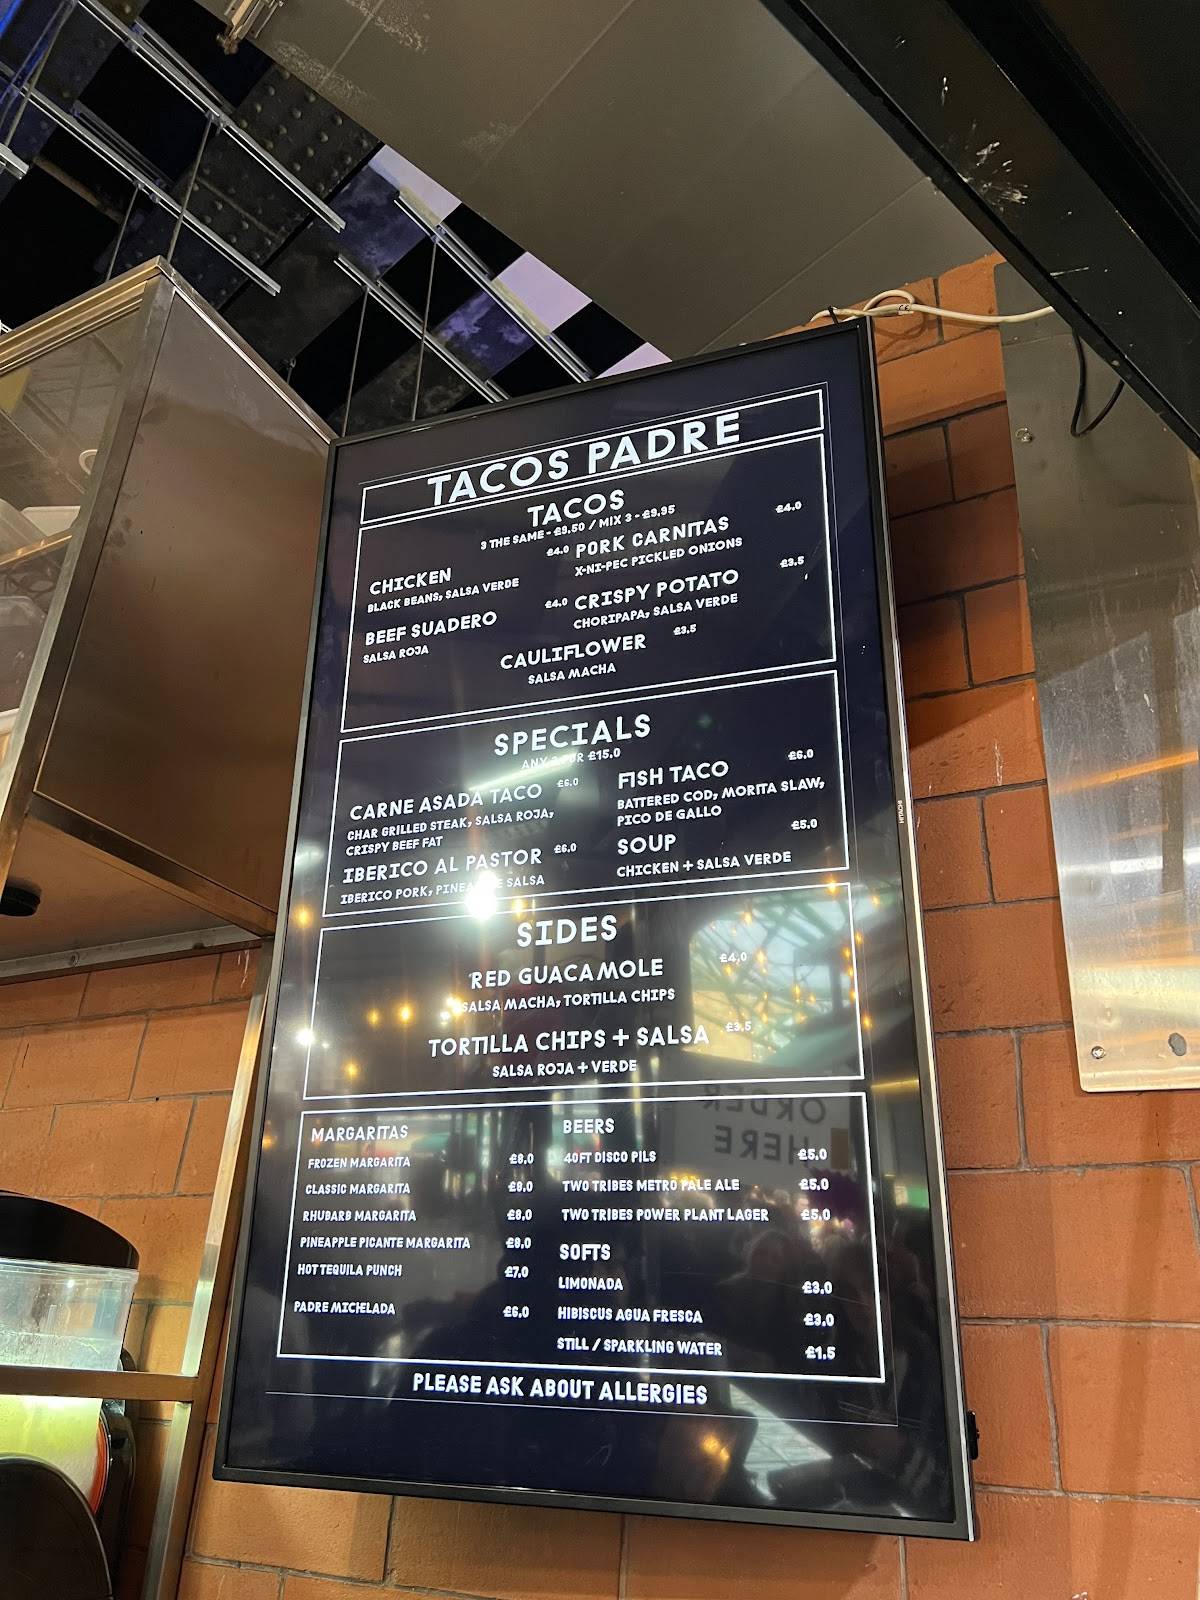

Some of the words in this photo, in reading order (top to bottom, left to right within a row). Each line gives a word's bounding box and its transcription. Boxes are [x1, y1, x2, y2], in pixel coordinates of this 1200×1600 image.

[427, 450, 570, 506] TACOS
[588, 412, 739, 474] PADRE
[528, 490, 625, 527] TACOS
[775, 501, 802, 513] £4.0
[480, 540, 487, 550] 3
[489, 536, 510, 548] THE
[512, 530, 545, 544] SAME
[599, 515, 622, 528] MIX
[625, 513, 632, 523] 3
[641, 505, 675, 519] £9.95
[575, 535, 625, 558] PORK
[632, 516, 729, 546] CARNITAS
[546, 545, 570, 557] £4.0
[574, 558, 628, 577] X-NI-PEC
[631, 548, 685, 566] PICKLED
[688, 537, 743, 556] ONIONS
[780, 556, 804, 568] £3.5
[369, 568, 452, 595] CHICKEN
[574, 583, 651, 611] CRISPY
[656, 569, 739, 598] POTATO
[367, 599, 401, 613] BLACK
[404, 591, 443, 608] BEANS,
[445, 585, 480, 599] SALSA
[482, 577, 520, 593] VERDE
[545, 598, 568, 609] £4.0
[573, 609, 650, 629] CHORIPAPA,
[653, 602, 693, 617] SALSA
[695, 593, 738, 609] VERDE
[365, 626, 407, 646] BEEF
[411, 611, 497, 638] SUADERO
[673, 623, 697, 636] £3.5
[363, 650, 397, 664] SALSA
[399, 645, 429, 658] ROJA
[500, 633, 646, 670] CAULIFLOWER
[528, 669, 565, 685] SALSA
[568, 662, 616, 679] MACHA
[494, 714, 651, 756] SPECIALS
[561, 752, 584, 765] OR
[588, 747, 621, 761] £15.0
[788, 749, 814, 761] £6.0
[557, 778, 579, 788] £6.0
[618, 768, 663, 789] FISH
[669, 760, 729, 783] TACO
[350, 799, 414, 821] CARNE
[419, 791, 483, 814] ASADA
[489, 784, 542, 804] TACO
[617, 792, 680, 810] BATTERED
[683, 788, 719, 803] COD,
[722, 783, 777, 799] MORITA
[781, 776, 825, 792] SLAW,
[347, 828, 378, 842] CHAR
[381, 822, 427, 837] GRILLED
[430, 818, 473, 832] STEAK,
[475, 813, 512, 826] SALSA
[516, 808, 554, 821] ROJA,
[617, 813, 652, 827] PICO
[655, 811, 672, 822] DE
[676, 805, 722, 820] GALLO
[791, 818, 818, 830] £5.0
[346, 842, 390, 857] CRISPY
[392, 839, 420, 851] BEEF
[422, 836, 443, 848] FAT
[554, 843, 577, 854] £6.0
[617, 834, 677, 855] SOUP
[343, 860, 428, 884] IBERICO
[434, 856, 459, 874] AL
[466, 848, 542, 870] PASTOR
[617, 861, 679, 878] CHICKEN
[696, 855, 740, 870] SALSA
[744, 851, 792, 865] VERDE
[340, 890, 393, 905] IBERICO
[395, 886, 433, 900] PORK,
[436, 878, 503, 895] PINEAE
[506, 875, 545, 888] SALSA
[517, 915, 617, 947] SIDES
[720, 952, 747, 963] £4.0
[469, 970, 511, 989] RED
[518, 958, 663, 986] GUACAMOLE
[504, 995, 561, 1011] MACHA,
[564, 991, 627, 1006] TORTILLA
[632, 988, 675, 1002] CHIPS
[726, 1021, 752, 1032] £3.5
[429, 1034, 528, 1058] TORTILLA
[535, 1029, 606, 1051] CHIPS
[637, 1025, 710, 1046] SALSA
[492, 1064, 533, 1078] SALSA
[537, 1062, 574, 1076] ROJA
[591, 1059, 637, 1073] VERDE
[311, 1125, 409, 1143] MARGARITAS
[563, 1118, 615, 1134] BEERS
[308, 1158, 347, 1169] FROZEN
[350, 1156, 410, 1169] MARGARITA
[564, 1152, 591, 1163] 40FT
[594, 1151, 628, 1163] DISCO
[631, 1151, 656, 1162] PILS
[798, 1149, 827, 1161] £5.0
[305, 1183, 347, 1195] CLASSIC
[349, 1183, 410, 1195] MARGARITA
[562, 1180, 590, 1192] TWO
[592, 1180, 633, 1192] TRIBES
[636, 1179, 678, 1191] METRO
[681, 1179, 711, 1191] PALE
[715, 1179, 740, 1191] ALE
[799, 1179, 829, 1190] £5.0
[302, 1210, 352, 1222] RHUBARB
[354, 1209, 416, 1222] MARGARITA
[562, 1209, 590, 1221] TWO
[591, 1209, 633, 1221] TRIBES
[636, 1209, 680, 1221] POWER
[684, 1209, 725, 1221] PLANT
[727, 1209, 769, 1222] LAGER
[801, 1209, 830, 1221] £5.0
[299, 1236, 358, 1248] PINEAPPLE
[359, 1236, 404, 1249] PICANTE
[406, 1237, 471, 1249] MARGARITA
[559, 1244, 611, 1261] SOFTS
[297, 1264, 319, 1276] HOT
[320, 1264, 363, 1277] TEQUILA
[366, 1265, 402, 1277] PUNCH
[504, 1266, 529, 1278] £7.0
[558, 1277, 624, 1291] LIMONADA
[802, 1281, 833, 1294] £3.0
[294, 1301, 329, 1313] PADRE
[329, 1302, 395, 1315] MICHELADA
[502, 1305, 529, 1318] £6.0
[557, 1307, 612, 1320] HIBISCUS
[615, 1308, 650, 1322] AGUA
[653, 1309, 703, 1324] FRESCA
[804, 1314, 834, 1327] £3.0
[557, 1338, 589, 1351] STILL
[604, 1339, 674, 1354] SPARKLING
[677, 1341, 723, 1356] WATER
[805, 1346, 835, 1360] £1.5
[413, 1373, 482, 1393] PLEASE
[485, 1375, 523, 1396] ASK
[530, 1377, 594, 1400] ABOUT
[599, 1381, 708, 1406] ALLERGIES
